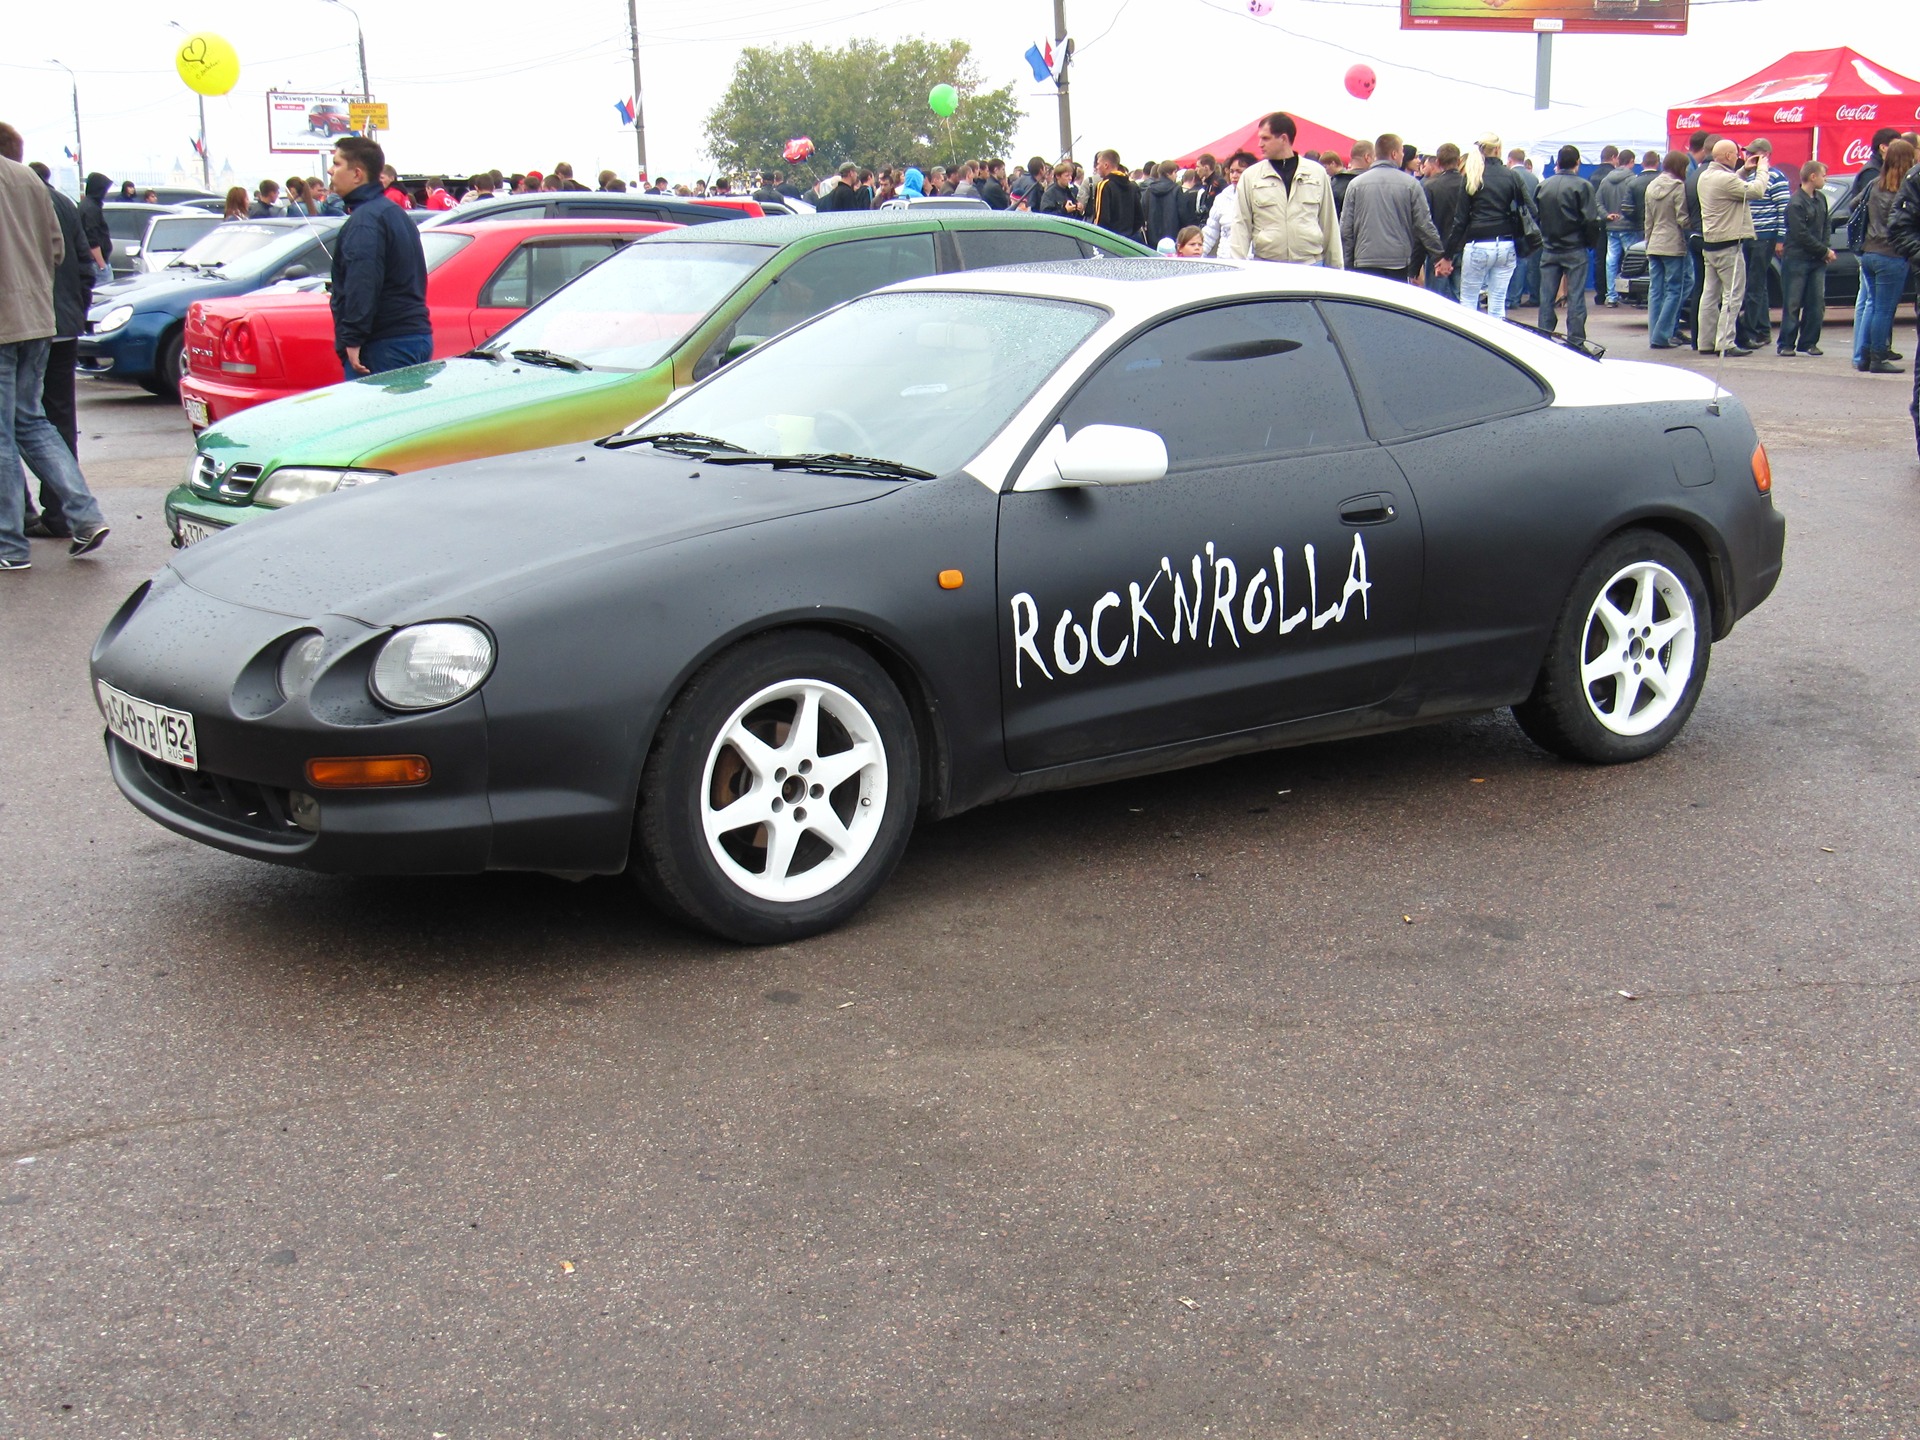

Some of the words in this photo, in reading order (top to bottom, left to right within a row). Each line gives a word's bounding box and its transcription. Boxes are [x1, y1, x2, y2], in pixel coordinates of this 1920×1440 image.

[1774, 106, 1804, 124] Coca-Cola
[1836, 104, 1878, 121] Coca-Cola
[160, 714, 190, 750] 152
[167, 746, 184, 760] RUS
